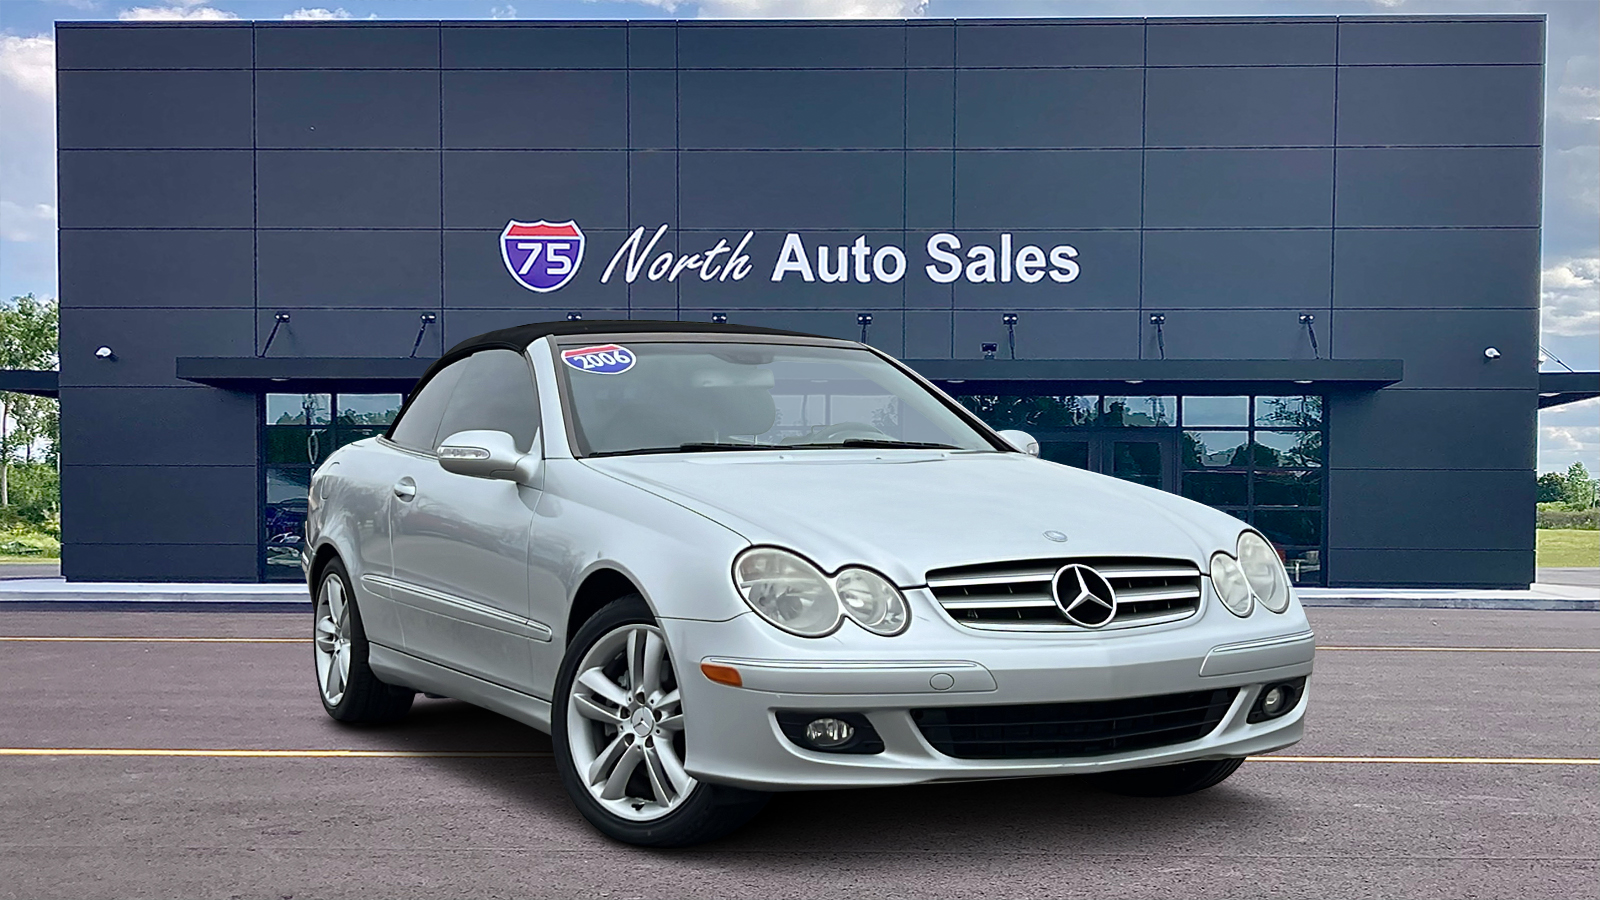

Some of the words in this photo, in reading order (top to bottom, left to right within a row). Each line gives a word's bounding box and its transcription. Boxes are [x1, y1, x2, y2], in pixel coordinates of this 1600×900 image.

[517, 242, 572, 275] 75
[601, 224, 754, 284] North
[771, 233, 906, 283] Auto
[925, 232, 1080, 283] Sales
[573, 350, 631, 369] 2006
